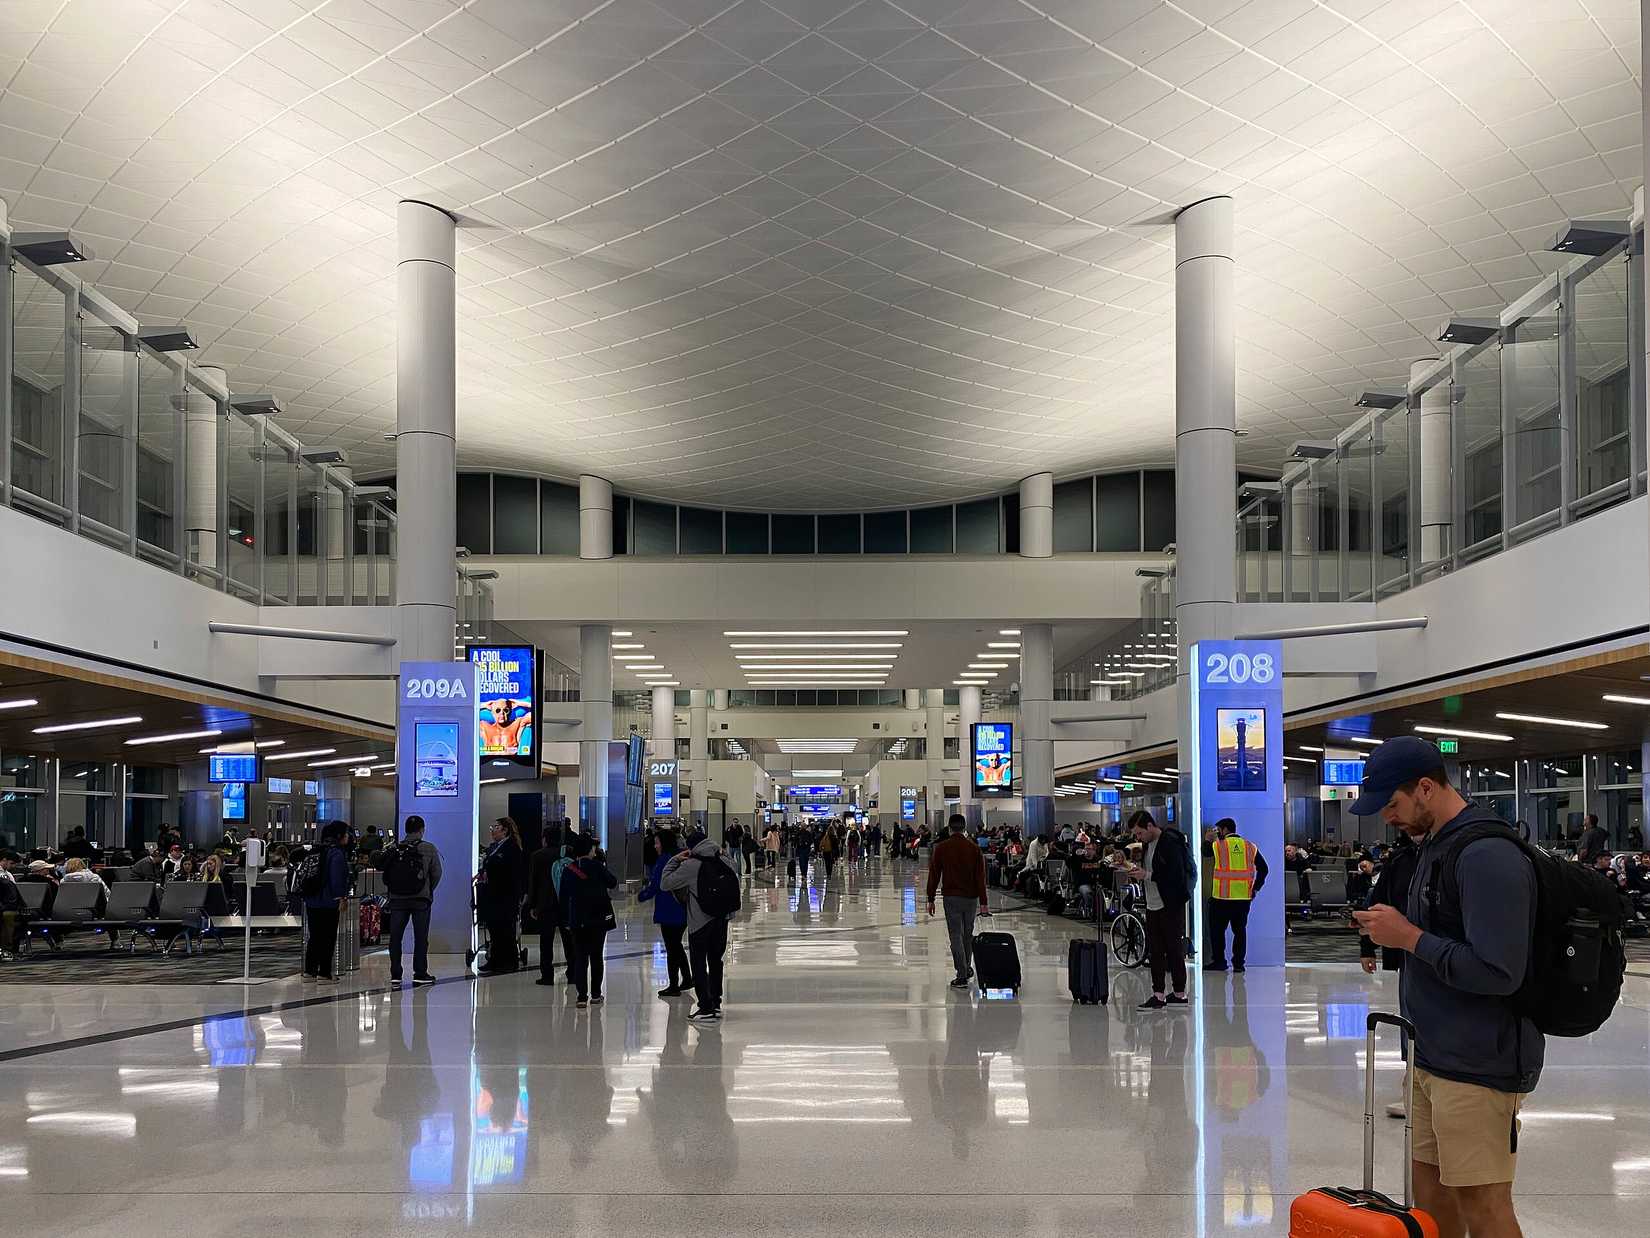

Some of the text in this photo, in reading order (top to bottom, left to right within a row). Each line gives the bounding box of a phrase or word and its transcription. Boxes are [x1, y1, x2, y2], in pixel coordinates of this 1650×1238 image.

[473, 650, 502, 662] A COOL
[488, 661, 520, 673] BILLION
[1206, 652, 1275, 684] 208
[479, 672, 510, 683] OLLARS
[406, 678, 467, 698] 209A
[479, 682, 520, 694] ECOVERED
[1440, 741, 1456, 753] EXIT
[650, 763, 676, 776] 207
